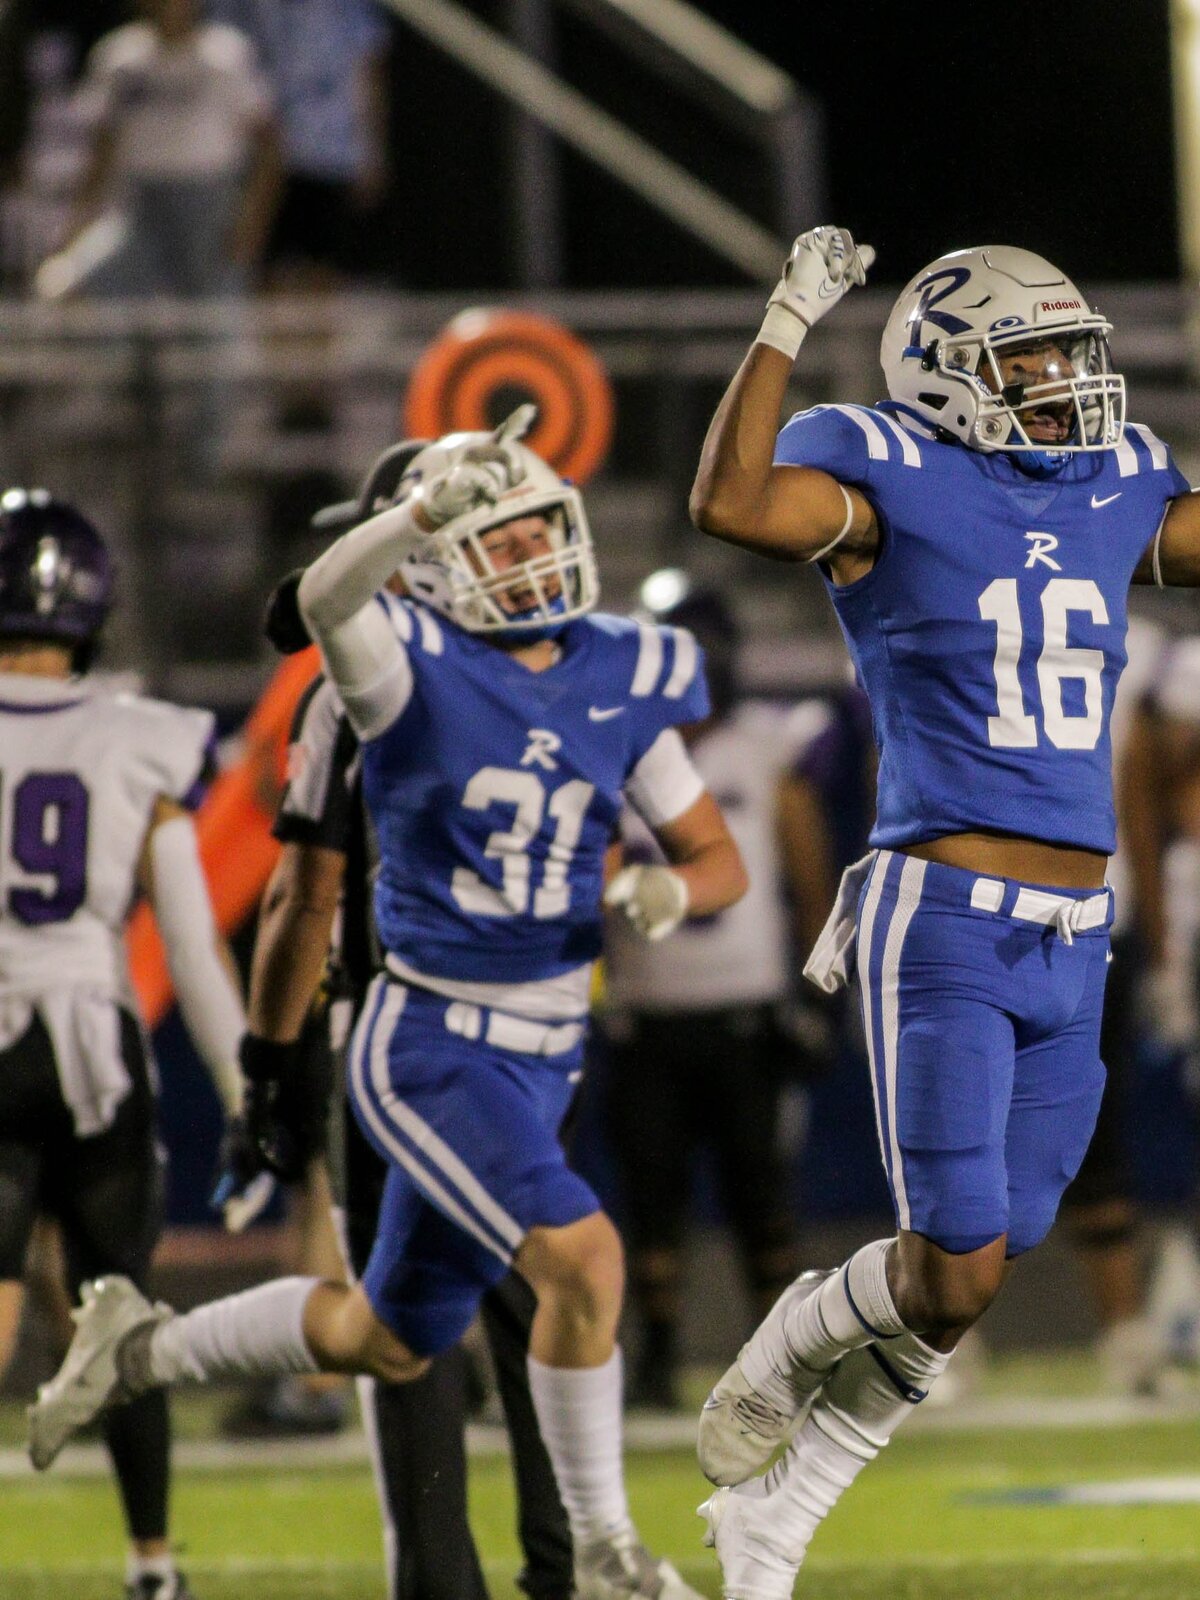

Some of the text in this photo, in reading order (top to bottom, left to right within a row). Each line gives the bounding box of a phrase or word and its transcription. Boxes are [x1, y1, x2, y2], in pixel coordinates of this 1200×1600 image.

[1041, 300, 1081, 312] Riddell
[1024, 532, 1062, 570] R
[978, 578, 1110, 749] 16
[520, 728, 562, 771] R
[0, 772, 88, 925] 9
[452, 766, 595, 919] 31
